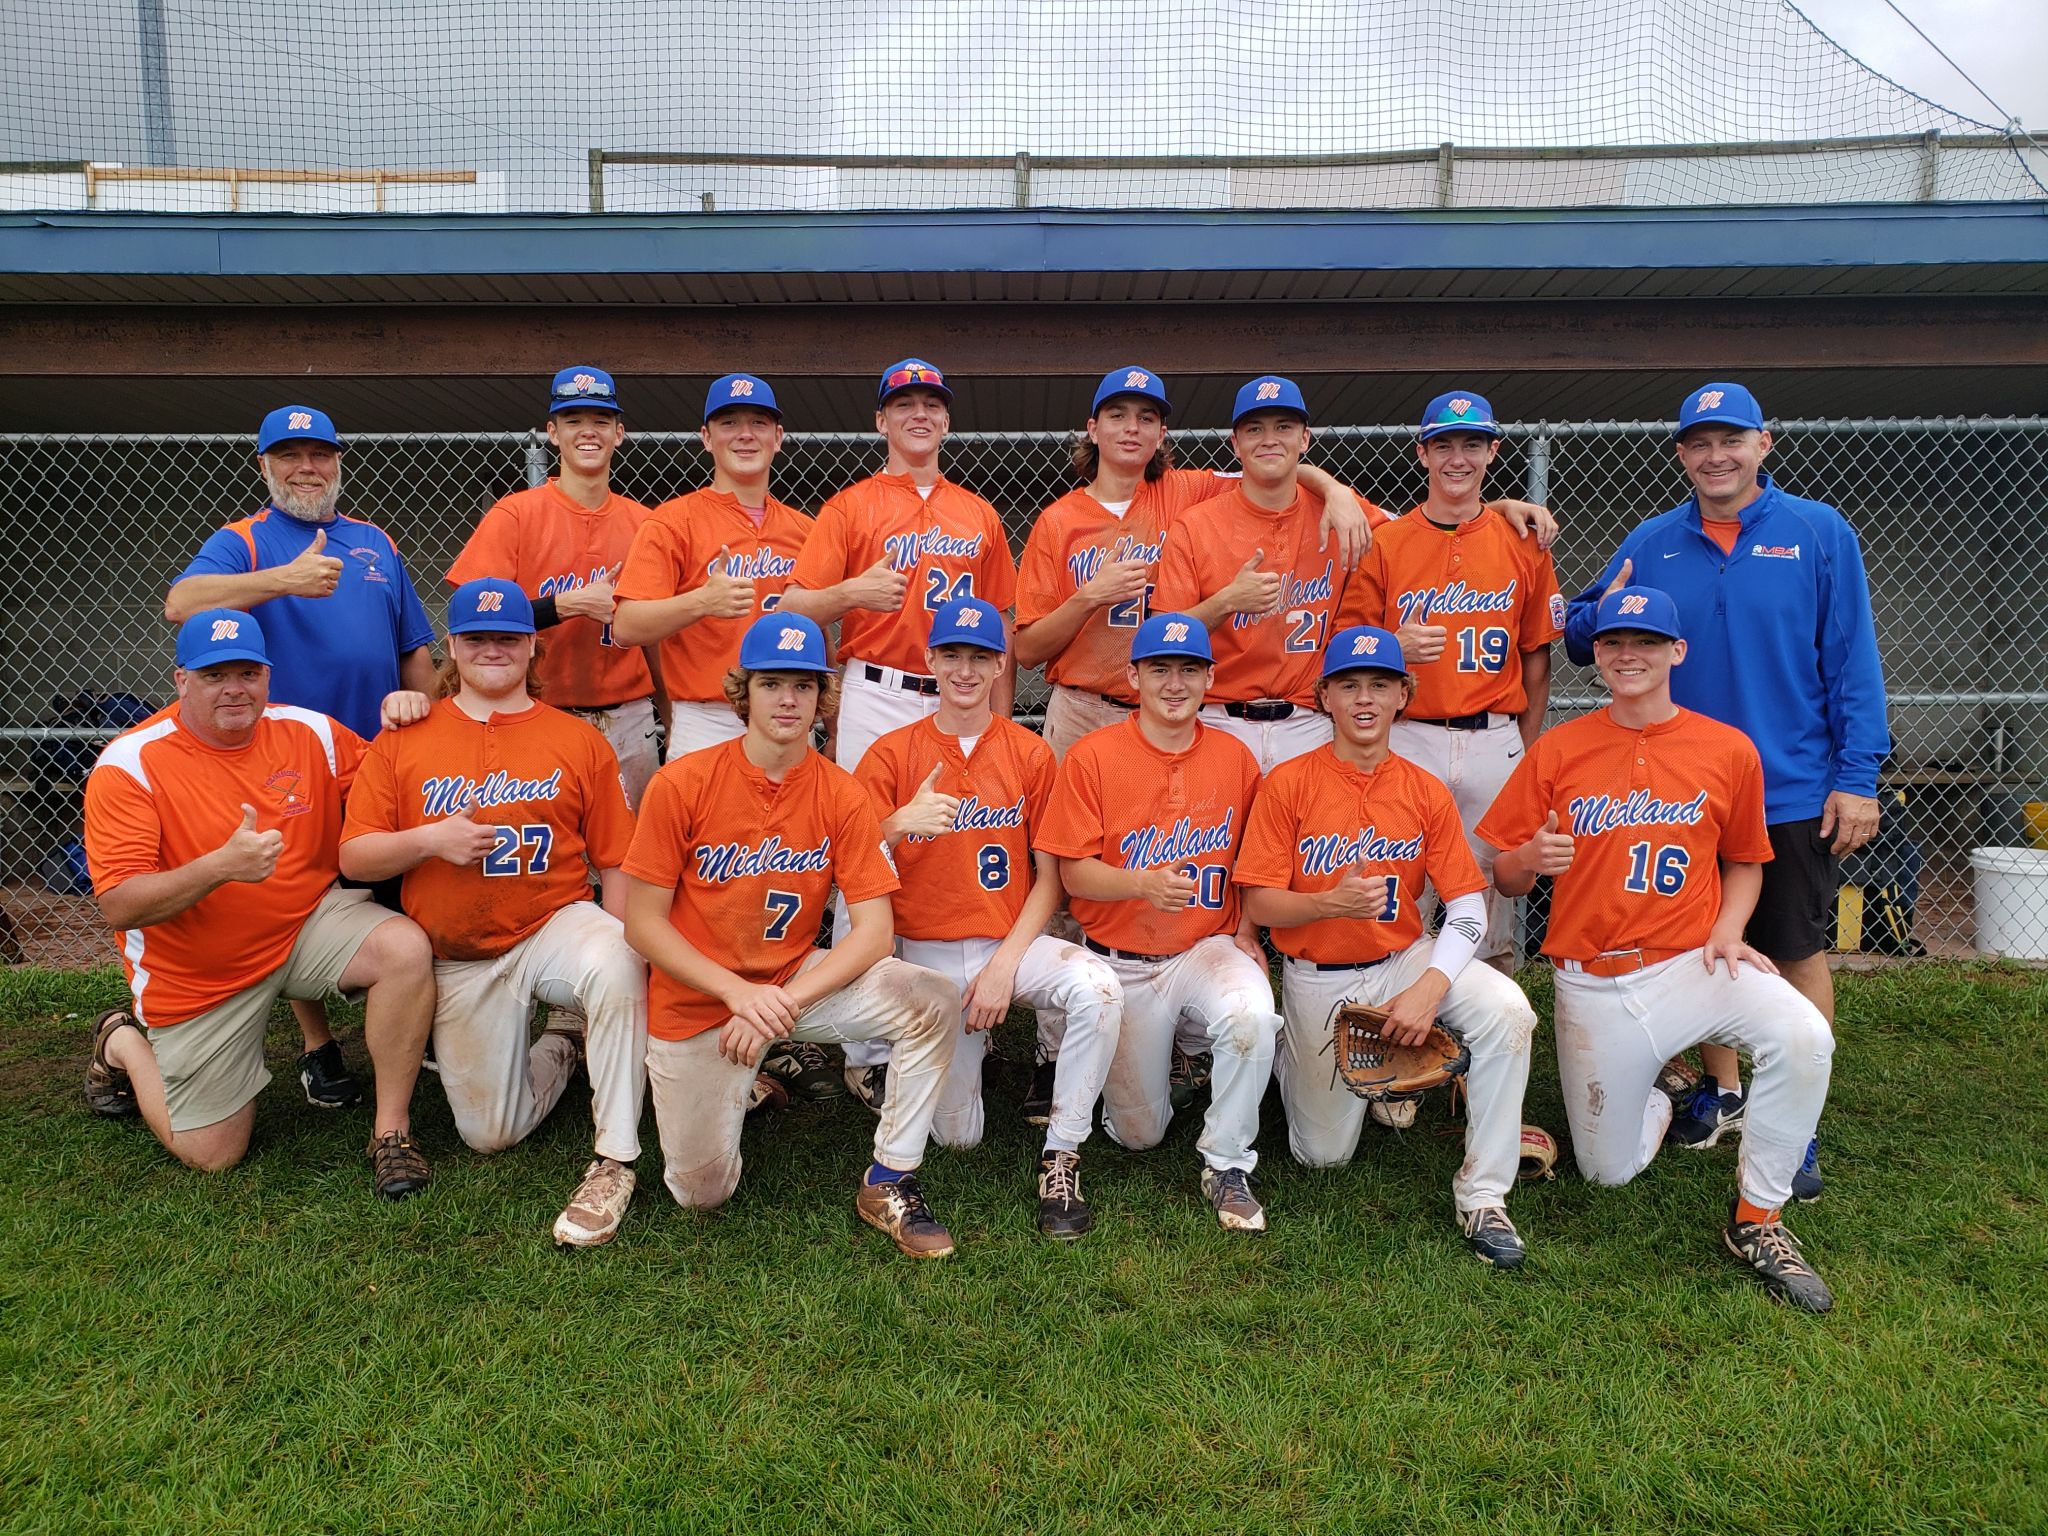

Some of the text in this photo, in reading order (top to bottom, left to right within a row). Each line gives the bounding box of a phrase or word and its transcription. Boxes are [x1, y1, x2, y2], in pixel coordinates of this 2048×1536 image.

[707, 546, 797, 578] Midlan
[1284, 610, 1329, 653] 21
[1456, 626, 1510, 674] 19
[422, 768, 562, 816] Midland
[1569, 788, 1708, 837] Midland
[483, 824, 554, 877] 27
[695, 835, 831, 884] Midland
[1120, 806, 1234, 871] Midland
[1299, 825, 1424, 877] Midland
[977, 844, 1010, 891] 8
[1624, 840, 1691, 898] 16
[763, 889, 803, 941] 7
